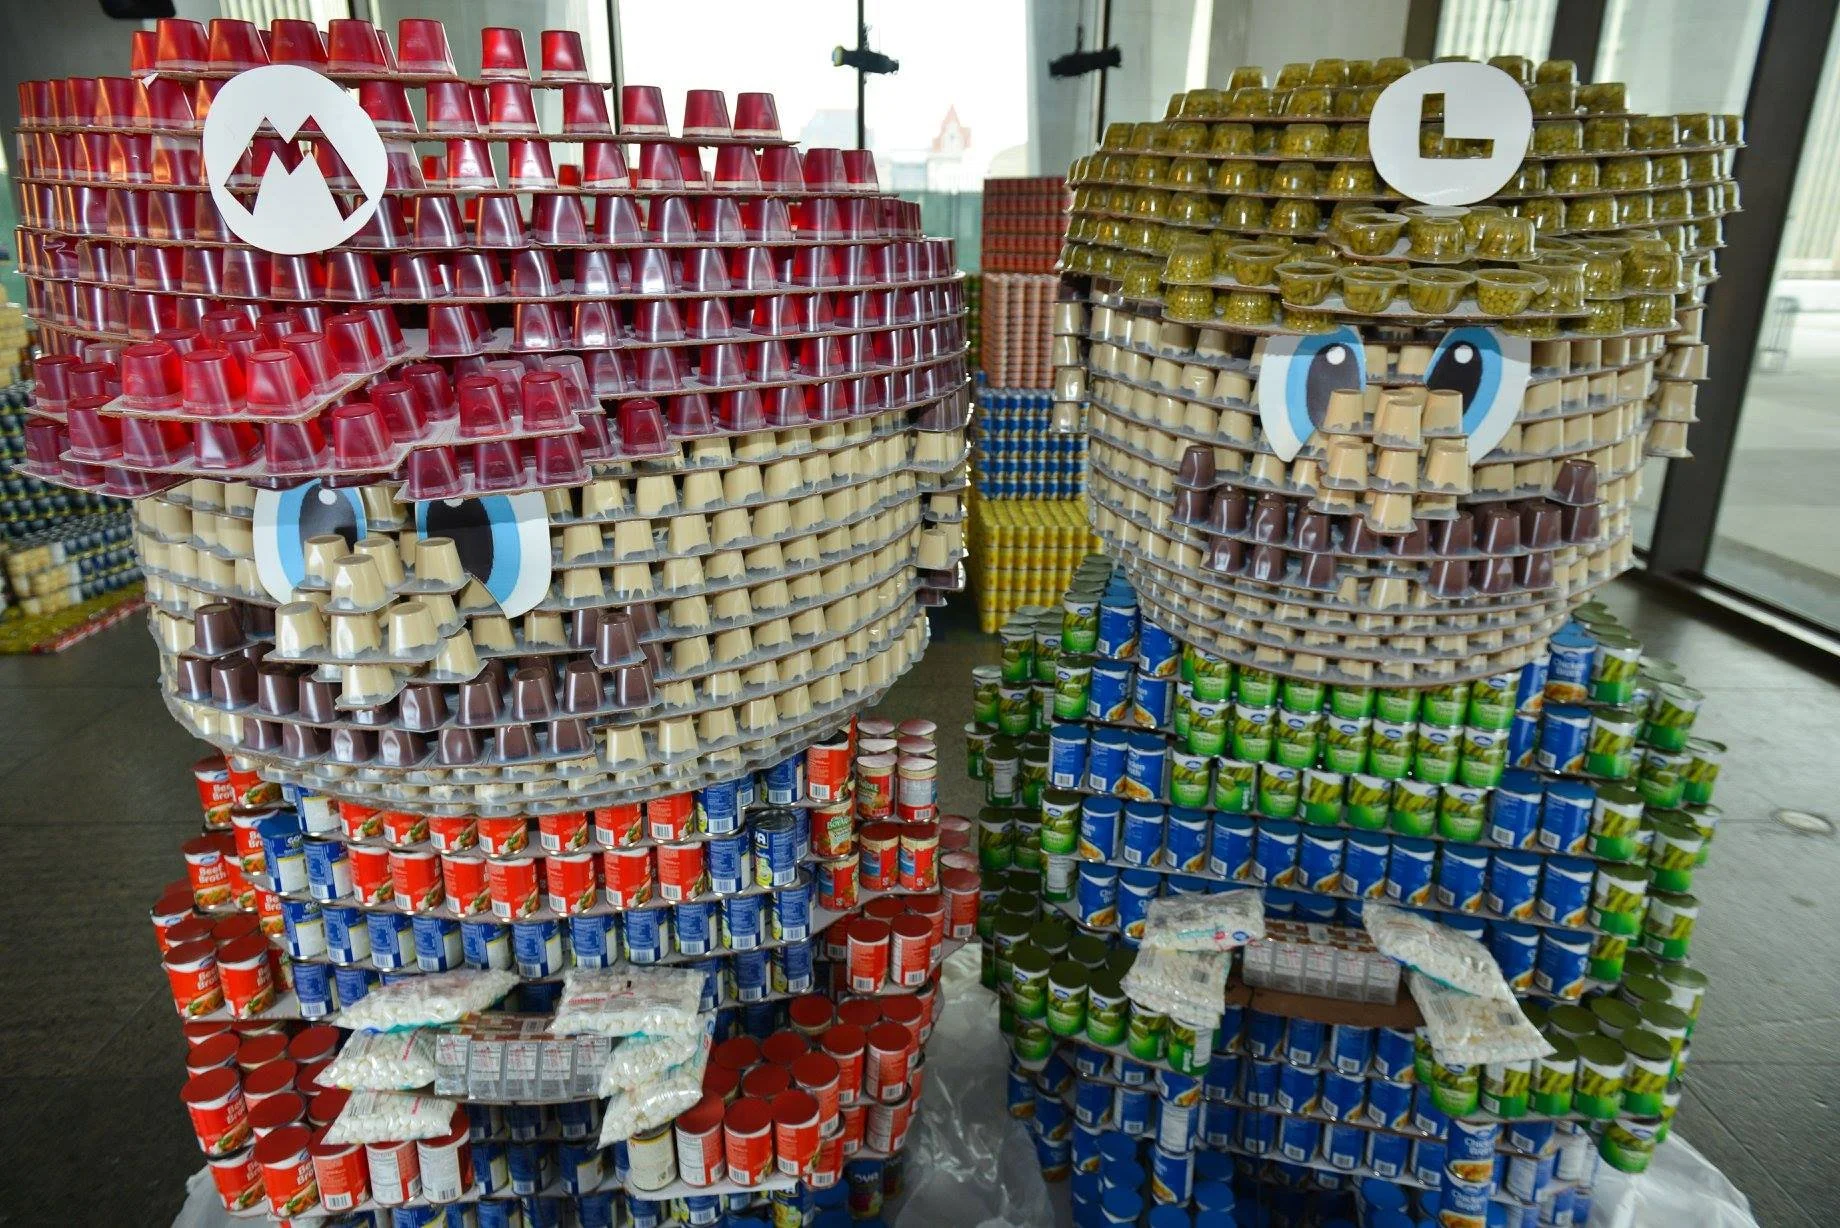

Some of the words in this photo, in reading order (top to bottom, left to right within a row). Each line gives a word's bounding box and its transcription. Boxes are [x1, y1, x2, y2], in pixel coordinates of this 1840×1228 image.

[1418, 92, 1495, 160] L
[223, 114, 369, 222] M
[213, 784, 232, 793] Bee
[213, 791, 234, 801] Bro
[198, 871, 227, 884] Broth
